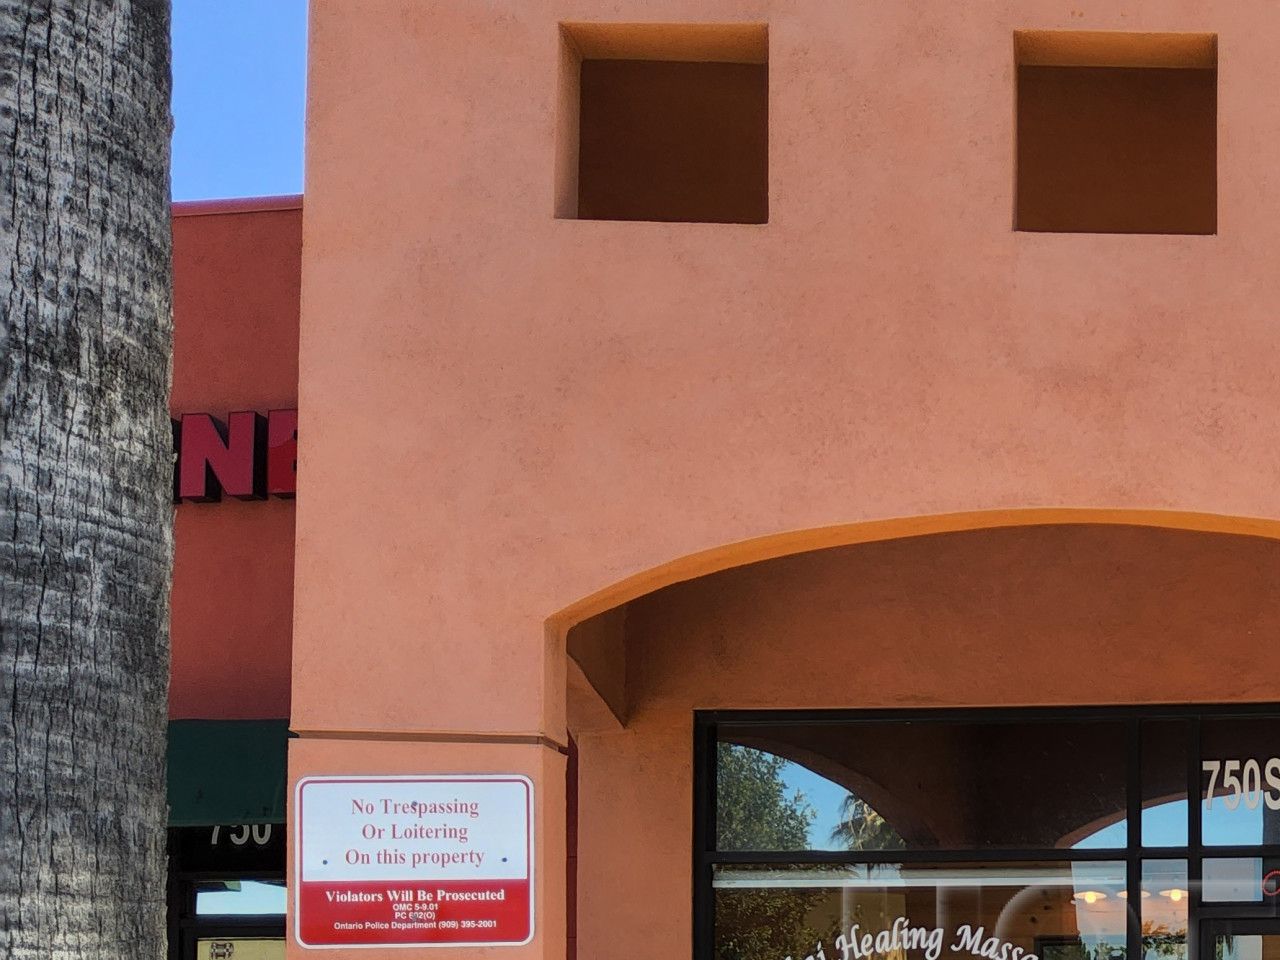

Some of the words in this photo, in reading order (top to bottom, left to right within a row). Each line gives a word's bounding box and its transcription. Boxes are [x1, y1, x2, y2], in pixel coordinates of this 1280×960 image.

[351, 798, 375, 815] No
[379, 798, 480, 819] Trespassing
[361, 823, 386, 840] Or
[391, 823, 469, 844] Loitering
[345, 848, 371, 865] On
[376, 848, 406, 865] this
[412, 849, 485, 869] property
[325, 890, 384, 903] Violators
[386, 889, 414, 903] Will
[417, 890, 434, 902] Be
[436, 889, 506, 901] Prosecuted
[392, 903, 413, 912] OMC
[414, 903, 439, 911] 5-9.01
[394, 911, 407, 920] PC
[333, 922, 364, 930] Ontario
[364, 921, 389, 930] Police
[391, 921, 437, 930] Department
[438, 920, 459, 930] (909)
[460, 920, 497, 929] 395-2001
